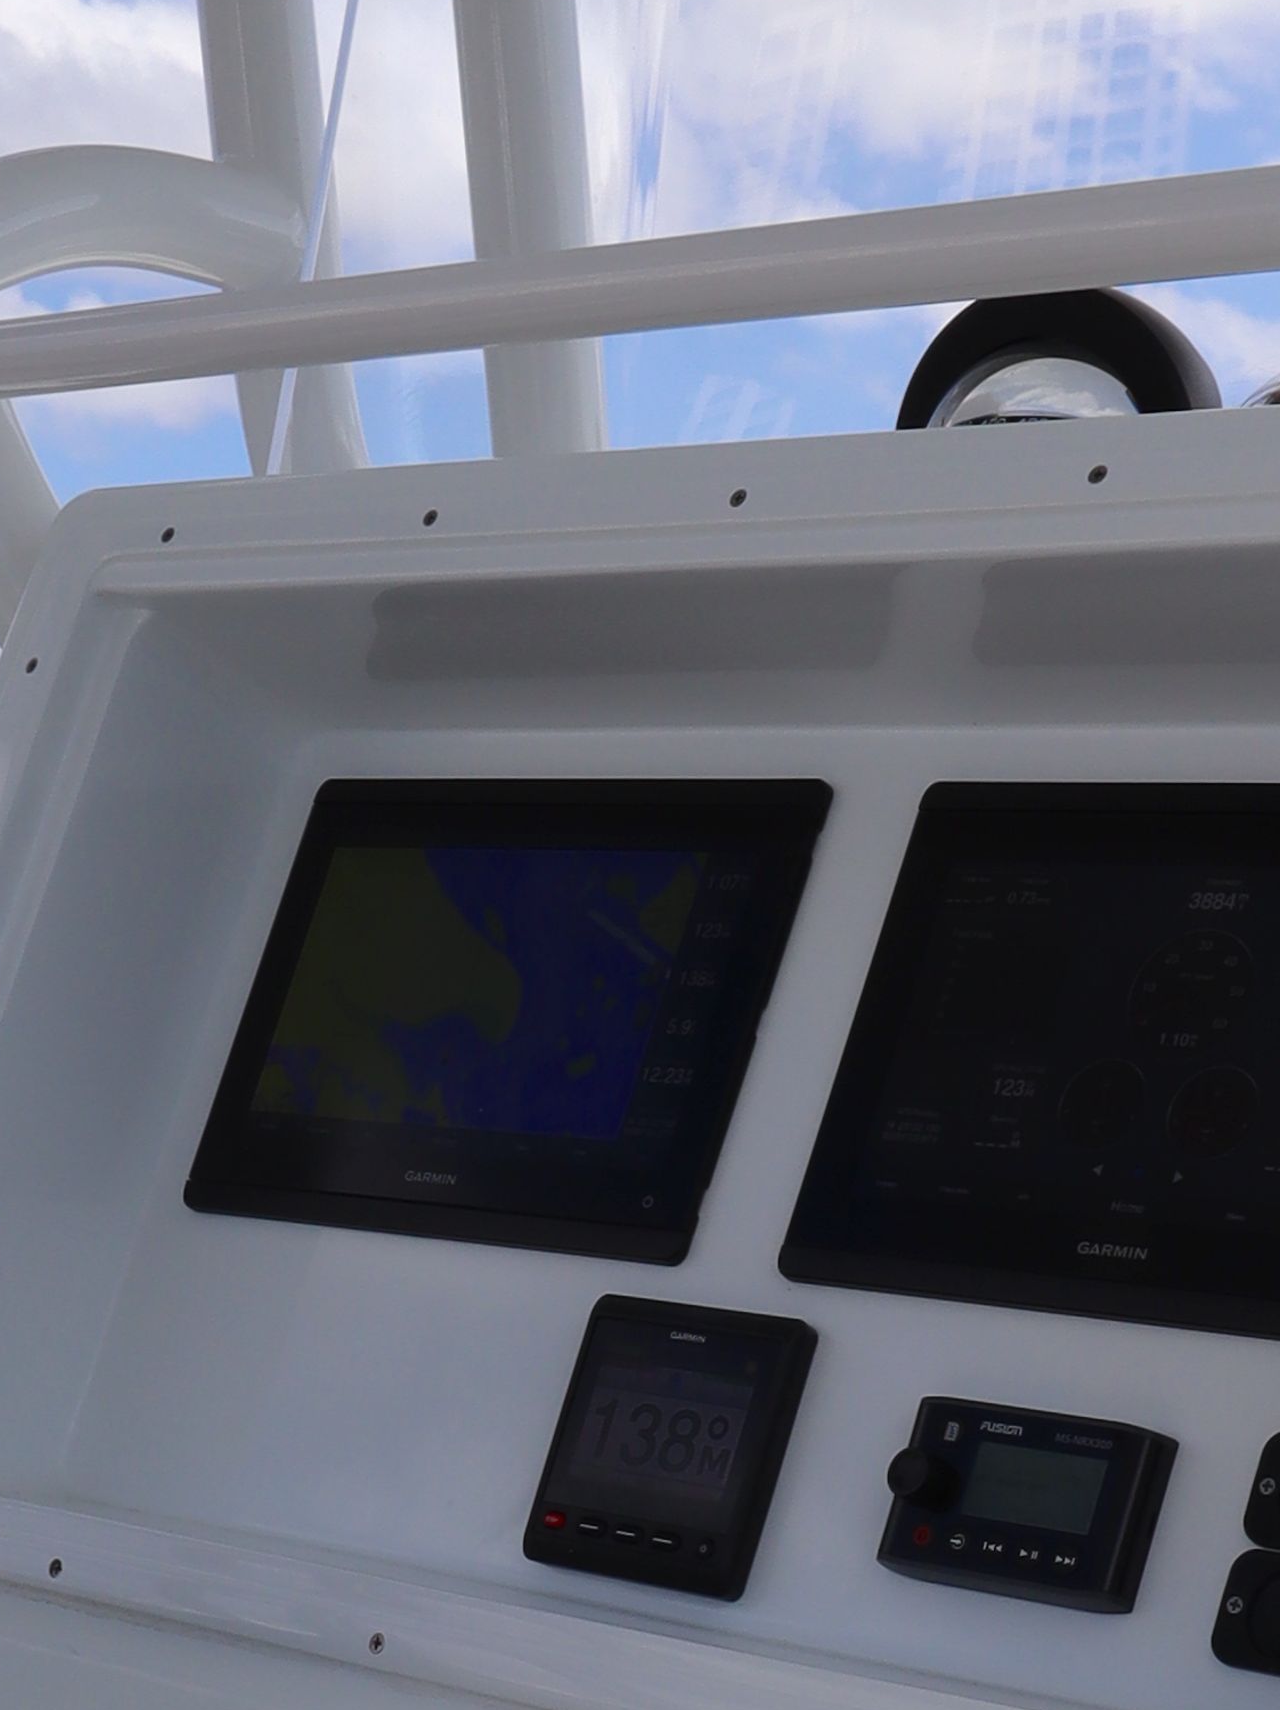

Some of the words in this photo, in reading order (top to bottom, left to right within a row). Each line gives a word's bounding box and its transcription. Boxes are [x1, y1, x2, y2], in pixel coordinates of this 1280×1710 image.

[404, 1170, 458, 1186] GARMIN
[1077, 1241, 1148, 1260] GARMIN
[670, 1330, 707, 1343] GARMIN
[979, 1421, 1024, 1437] FUSION
